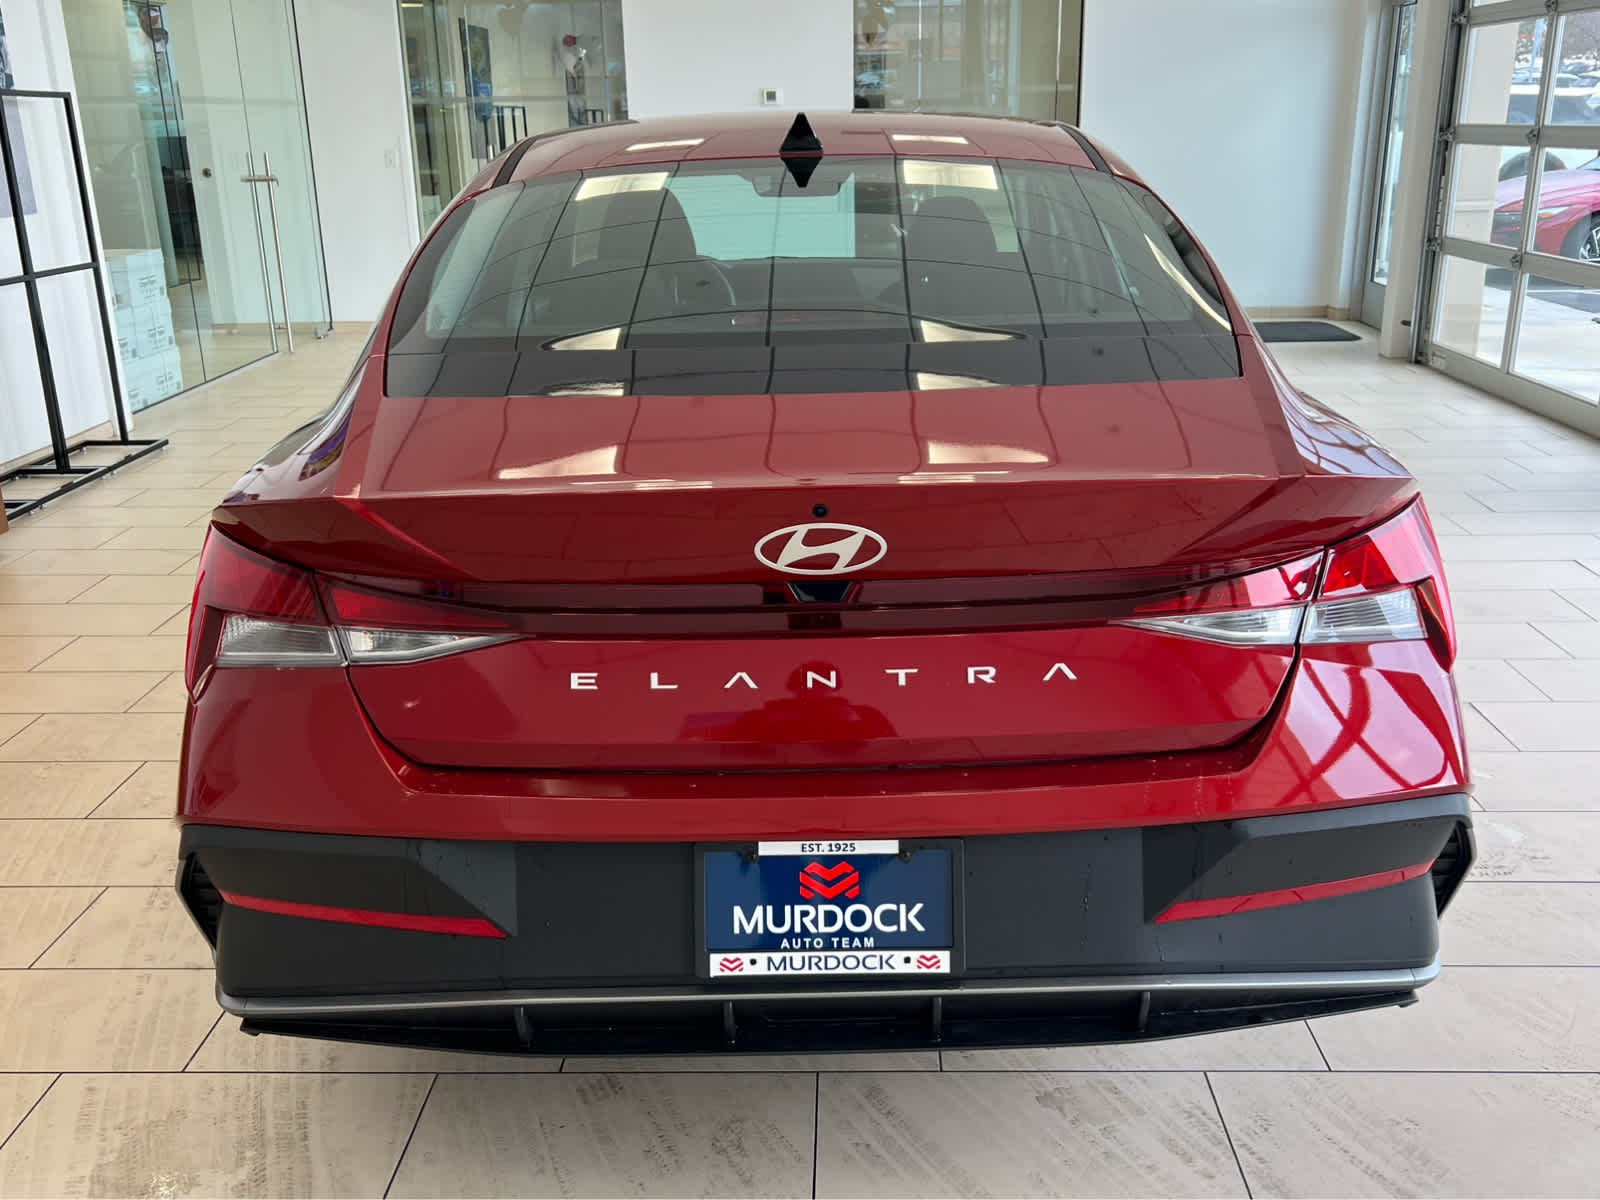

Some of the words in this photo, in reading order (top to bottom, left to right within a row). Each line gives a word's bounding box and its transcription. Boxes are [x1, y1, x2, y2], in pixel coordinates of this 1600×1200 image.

[569, 662, 1078, 691] ELANTRA
[801, 843, 825, 853] EST.
[827, 842, 856, 853] 1925
[733, 903, 925, 934] MURDOCK
[780, 938, 824, 949] AUTO
[831, 937, 875, 948] TEAM
[767, 954, 896, 971] MURDOCK
